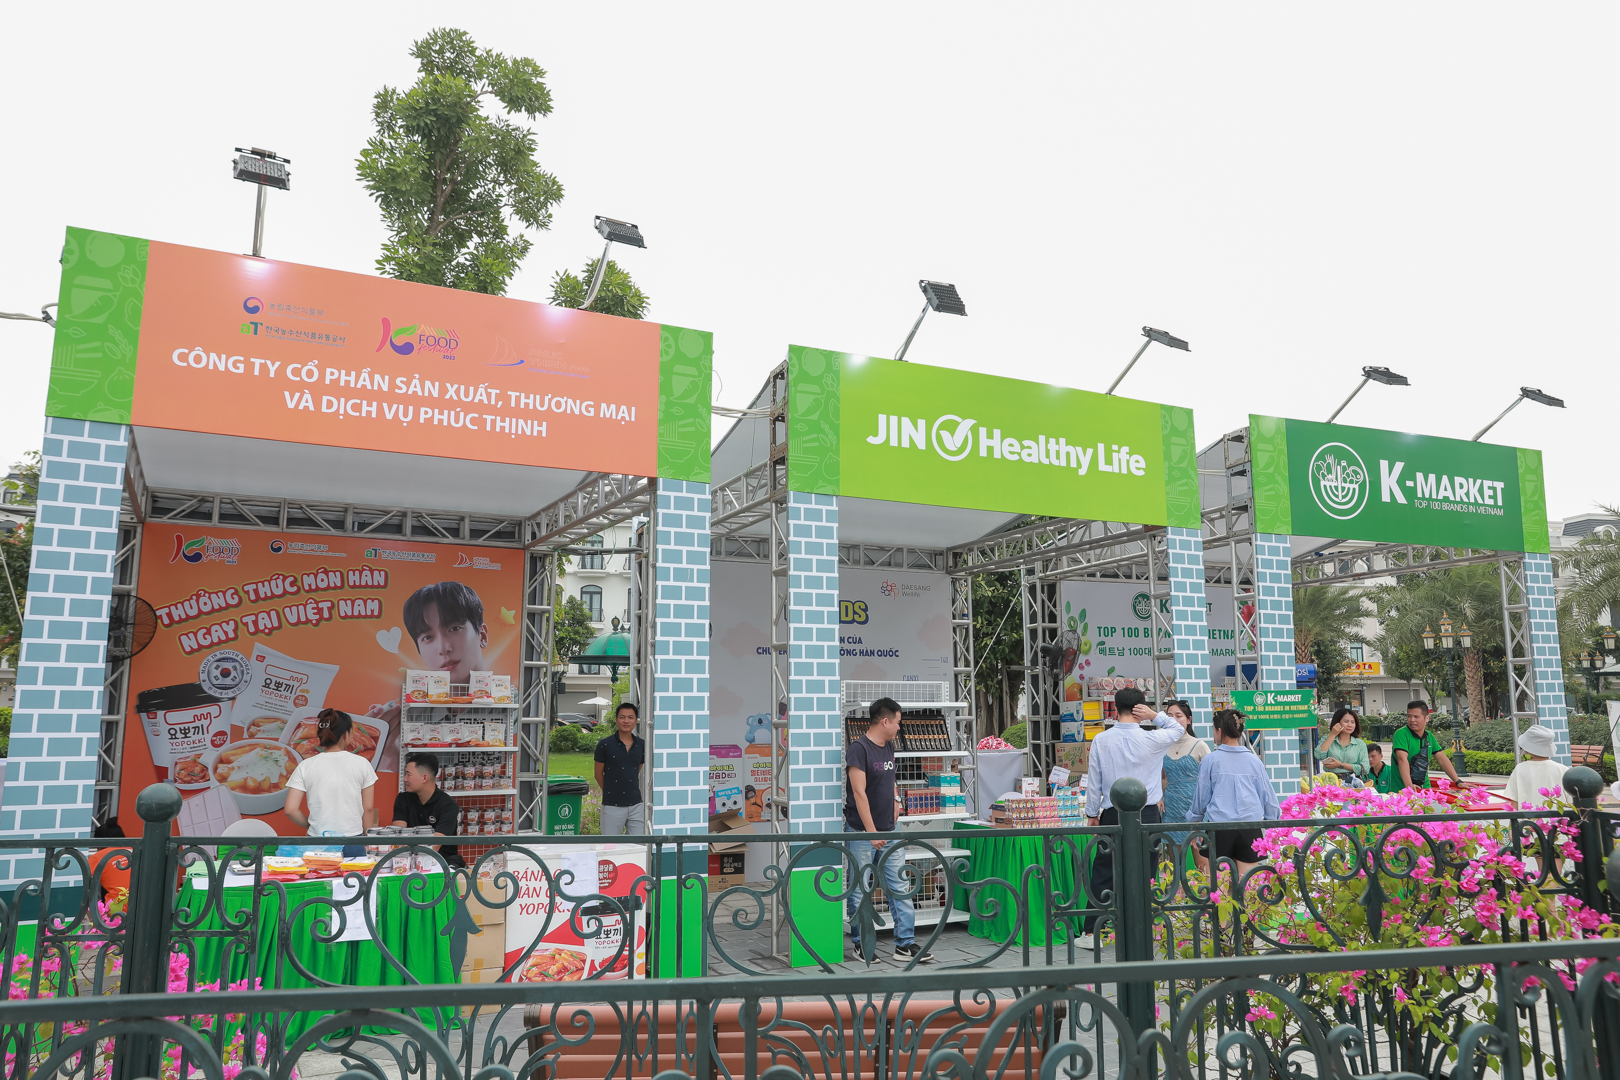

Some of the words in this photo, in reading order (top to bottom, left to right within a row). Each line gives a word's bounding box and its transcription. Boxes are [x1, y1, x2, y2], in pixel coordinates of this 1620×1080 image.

[418, 334, 458, 350] FOOD
[172, 346, 245, 374] CÔNG
[250, 358, 281, 378] TY
[286, 360, 319, 382] CỔ
[324, 368, 389, 392] PHẦN
[394, 374, 440, 398] SẢN
[444, 382, 502, 408] XUẤT,
[507, 390, 594, 417] THƯƠNG
[600, 402, 636, 425] MẠI
[284, 389, 314, 411] VÀ
[322, 395, 377, 420] DỊCH
[382, 402, 413, 426] VỤ
[420, 408, 479, 430] PHÚC
[482, 414, 547, 438] THỊNH
[866, 414, 926, 450] JIN
[979, 426, 1094, 476] Healthy
[1098, 442, 1146, 476] Life
[1379, 459, 1504, 506] K-MARKET
[1414, 500, 1428, 508] TOP
[1430, 501, 1441, 510] 100
[1442, 502, 1468, 513] BRANDS
[1469, 504, 1476, 514] IN
[1476, 505, 1504, 516] VIETNAM
[206, 545, 240, 556] FOOD
[155, 588, 240, 625] THƯỞNG
[244, 574, 298, 601] THỨC
[302, 568, 342, 591] MÓN
[348, 565, 386, 586] HÀN
[902, 584, 931, 592] DAESANG
[902, 590, 920, 598] Wellife
[179, 620, 236, 652] NGAY
[242, 610, 280, 634] TẠI
[284, 598, 332, 624] VIỆT
[338, 599, 380, 616] NAM
[1096, 626, 1116, 638] TOP
[1120, 626, 1138, 638] 100
[847, 634, 863, 644] CỦA
[859, 647, 876, 657] HÀN
[876, 646, 900, 658] QUỐC
[1098, 646, 1125, 656] 베트남
[200, 658, 212, 674] MADE
[219, 650, 240, 658] SOUTH
[240, 656, 250, 676] KOREA
[261, 677, 295, 695] 요뽀끼
[260, 688, 292, 701] YOPOKKI
[1268, 692, 1302, 704] K-MARKET
[167, 724, 205, 740] 요뽀끼
[169, 737, 206, 748] YOPOKKI
